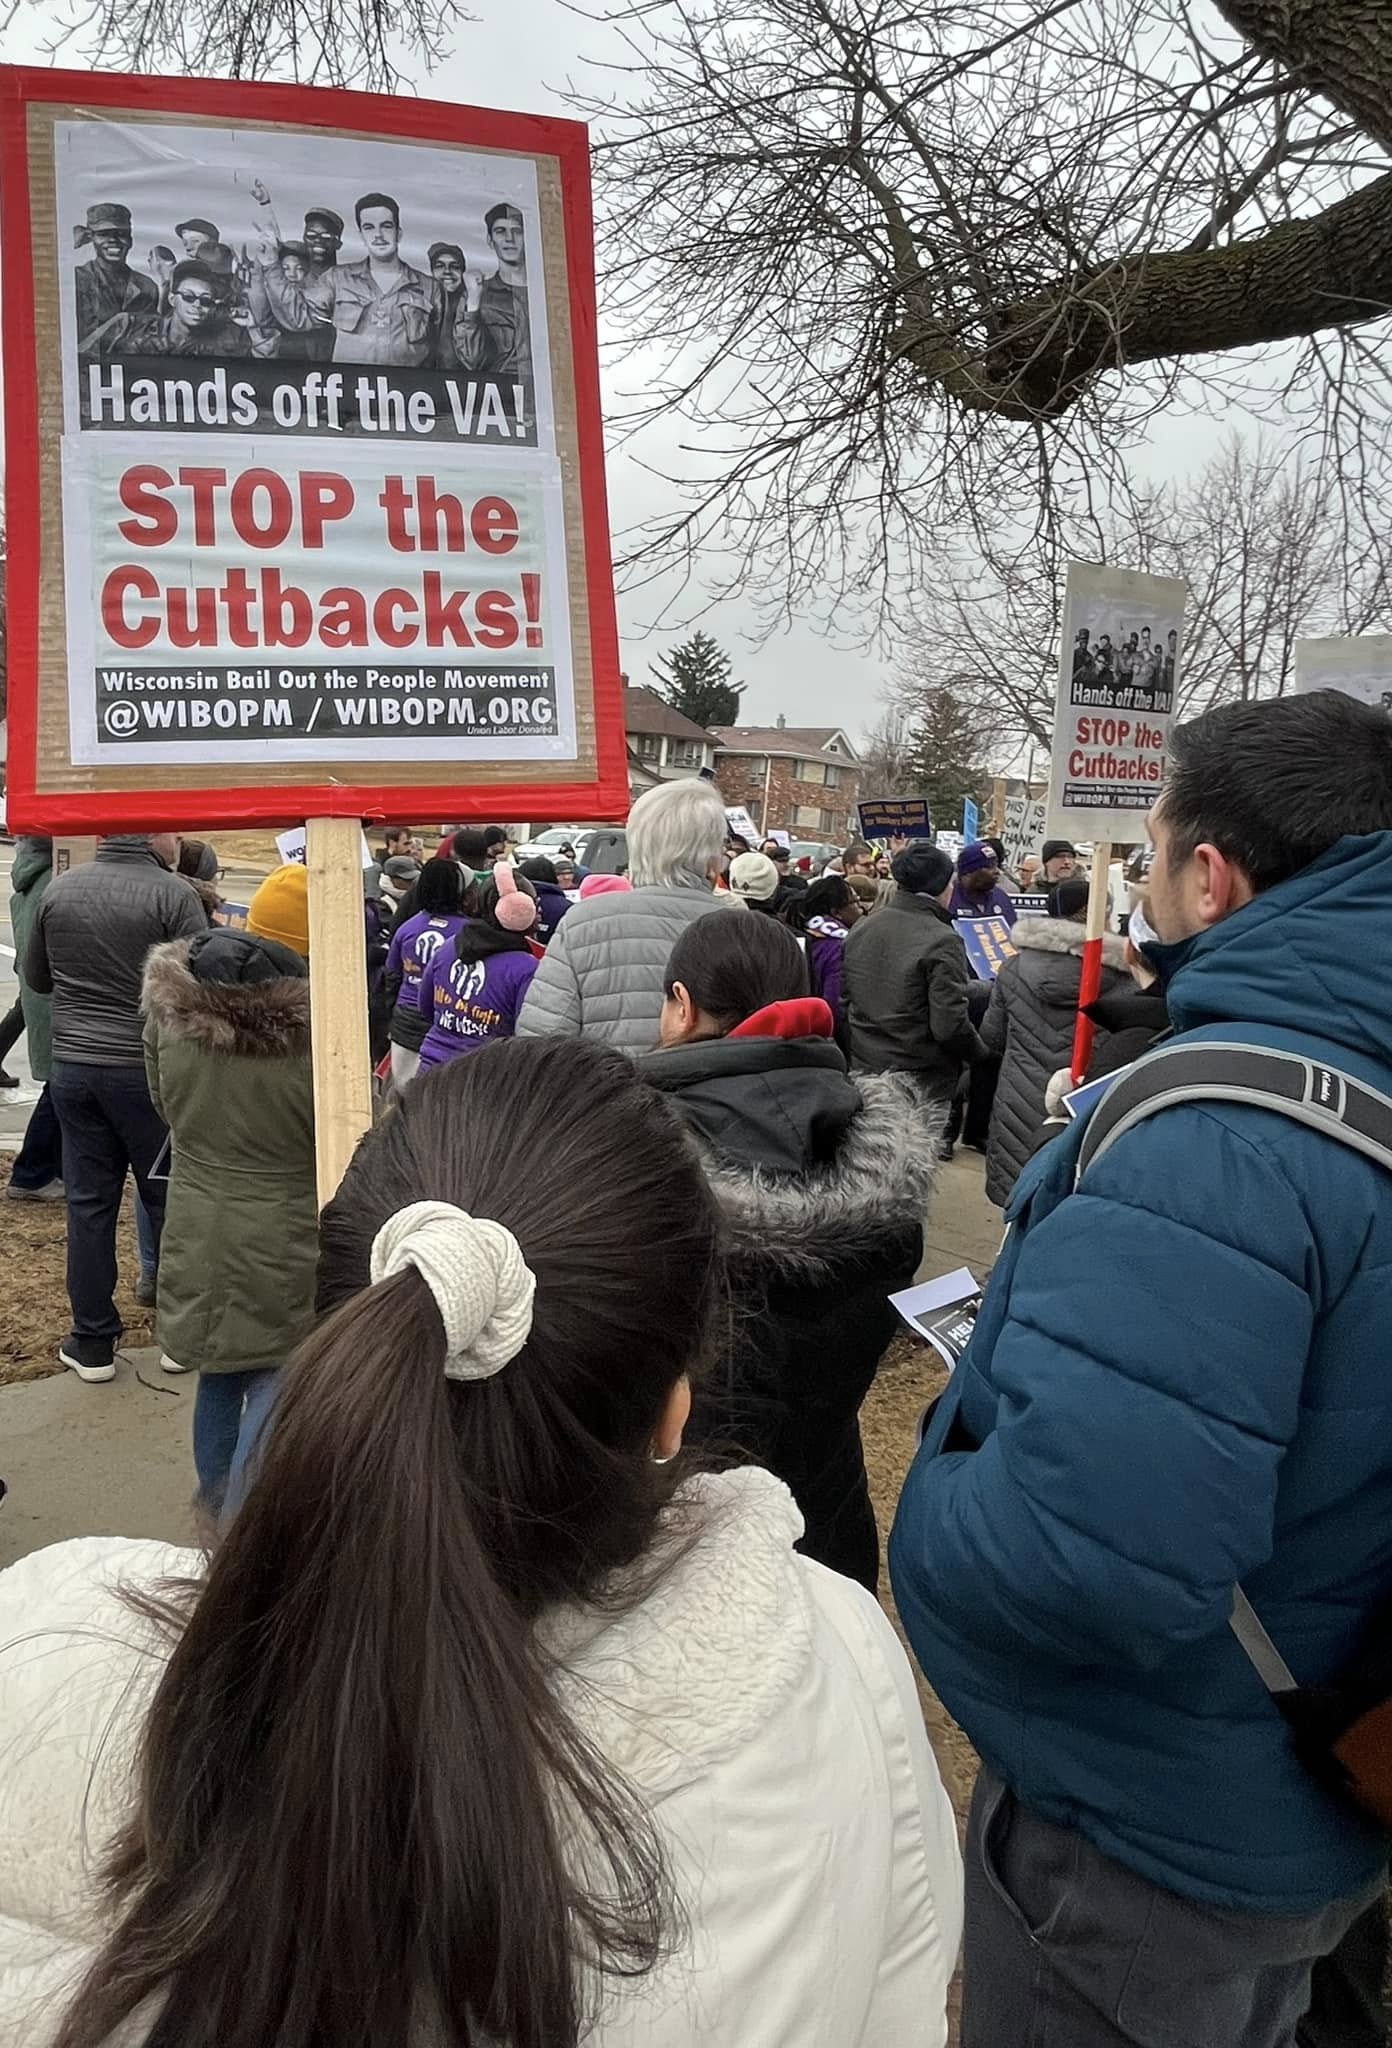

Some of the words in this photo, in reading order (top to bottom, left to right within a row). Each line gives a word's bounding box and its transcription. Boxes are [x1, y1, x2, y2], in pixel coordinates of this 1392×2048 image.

[88, 363, 258, 427] Hands
[272, 371, 344, 432] off
[355, 375, 437, 434] the
[445, 380, 527, 439] VA!
[117, 464, 355, 549] STOP
[378, 475, 519, 554] the
[101, 563, 543, 649] Cutbacks!
[102, 670, 219, 692] Wisconsin
[227, 669, 271, 690] Bail
[278, 670, 317, 690] Out
[323, 669, 358, 690] the
[366, 670, 436, 693] People
[443, 671, 550, 690] Movement
[1072, 682, 1114, 706] Hands
[1115, 687, 1134, 707] off
[1133, 688, 1153, 710] the
[104, 699, 294, 736] @WIBOPM
[305, 697, 323, 733] /
[334, 697, 553, 725] WIBOPM.ORG
[467, 726, 492, 735] Union
[493, 726, 517, 735] Labor
[518, 726, 553, 735] Donated
[1076, 716, 1130, 746] STOP
[1134, 721, 1163, 749] the
[1068, 749, 1166, 781] Cutbacks!
[1006, 800, 1025, 814] HIS
[1033, 805, 1046, 818] IS
[1000, 831, 1036, 849] THANK
[1005, 817, 1021, 829] OW
[1029, 820, 1046, 834] WE
